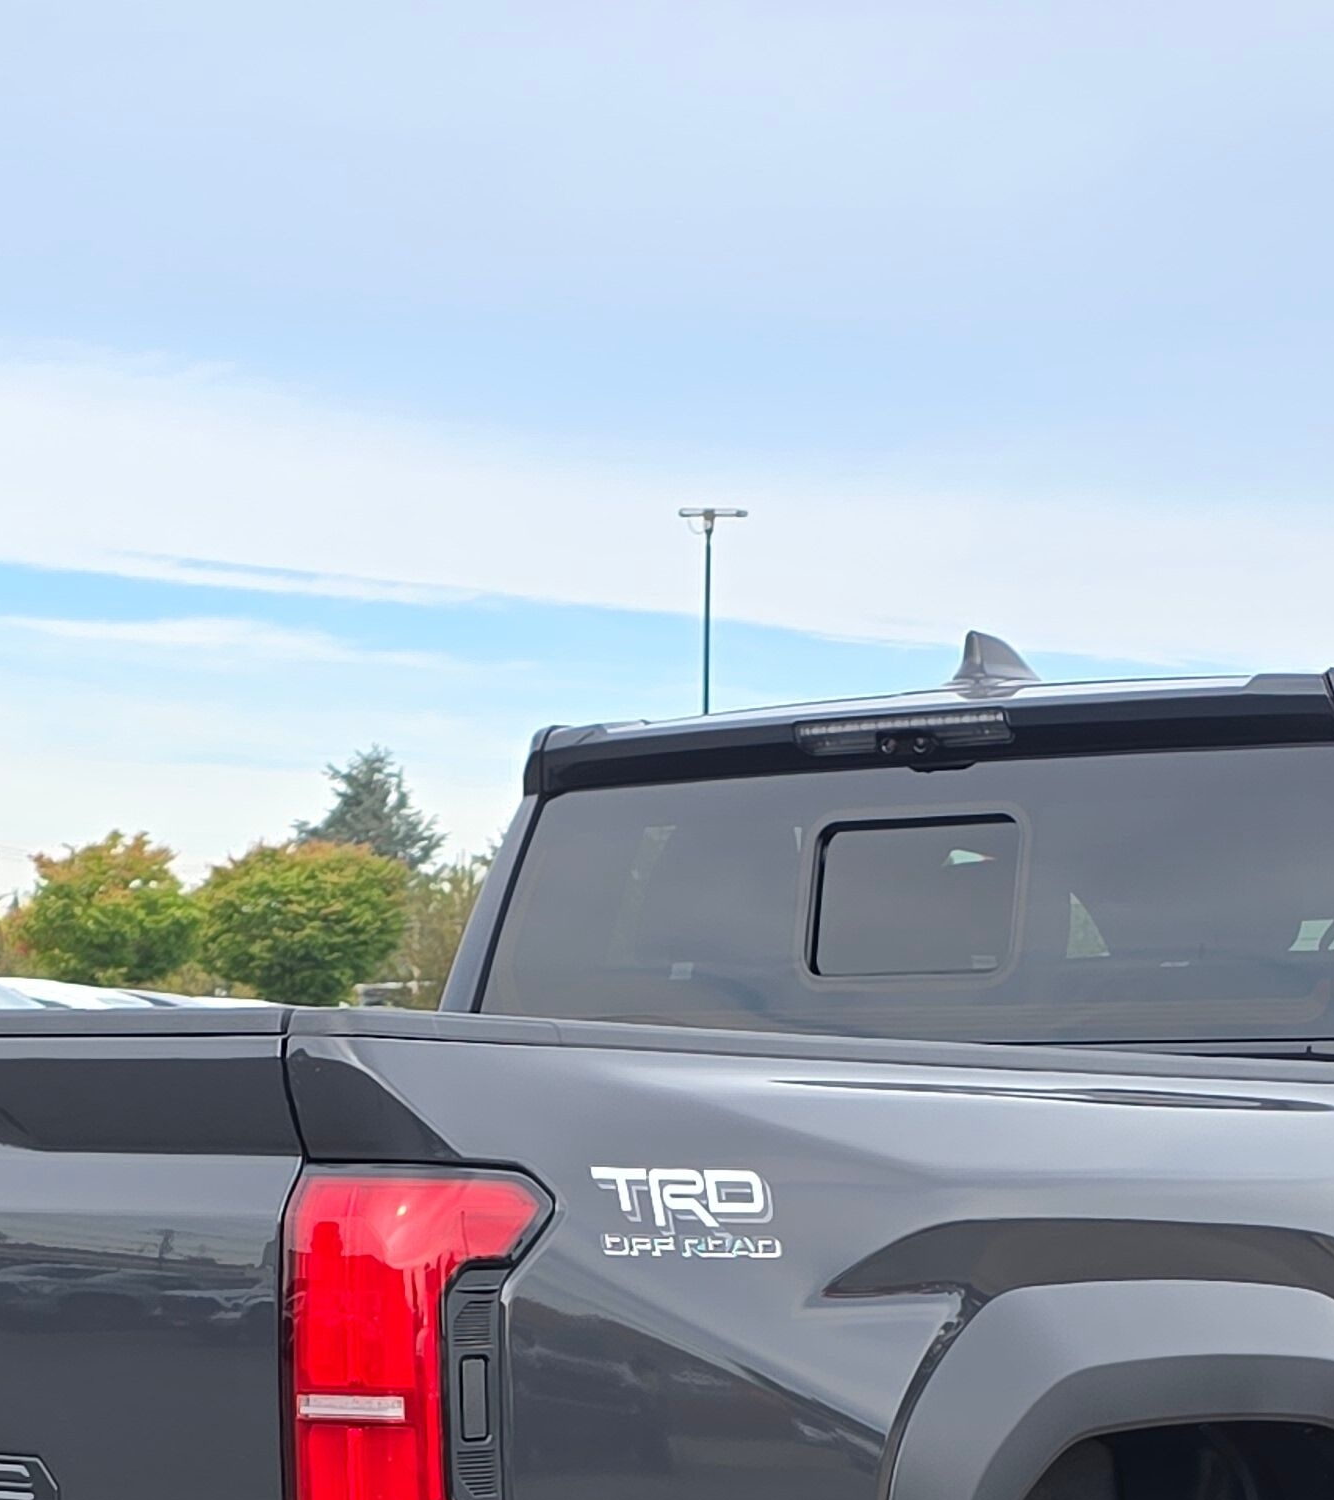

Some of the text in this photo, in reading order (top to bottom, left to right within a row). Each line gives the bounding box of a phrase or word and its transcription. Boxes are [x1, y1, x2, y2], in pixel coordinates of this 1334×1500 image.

[590, 1166, 773, 1236] TRD
[601, 1234, 781, 1259] OFF ROAD
